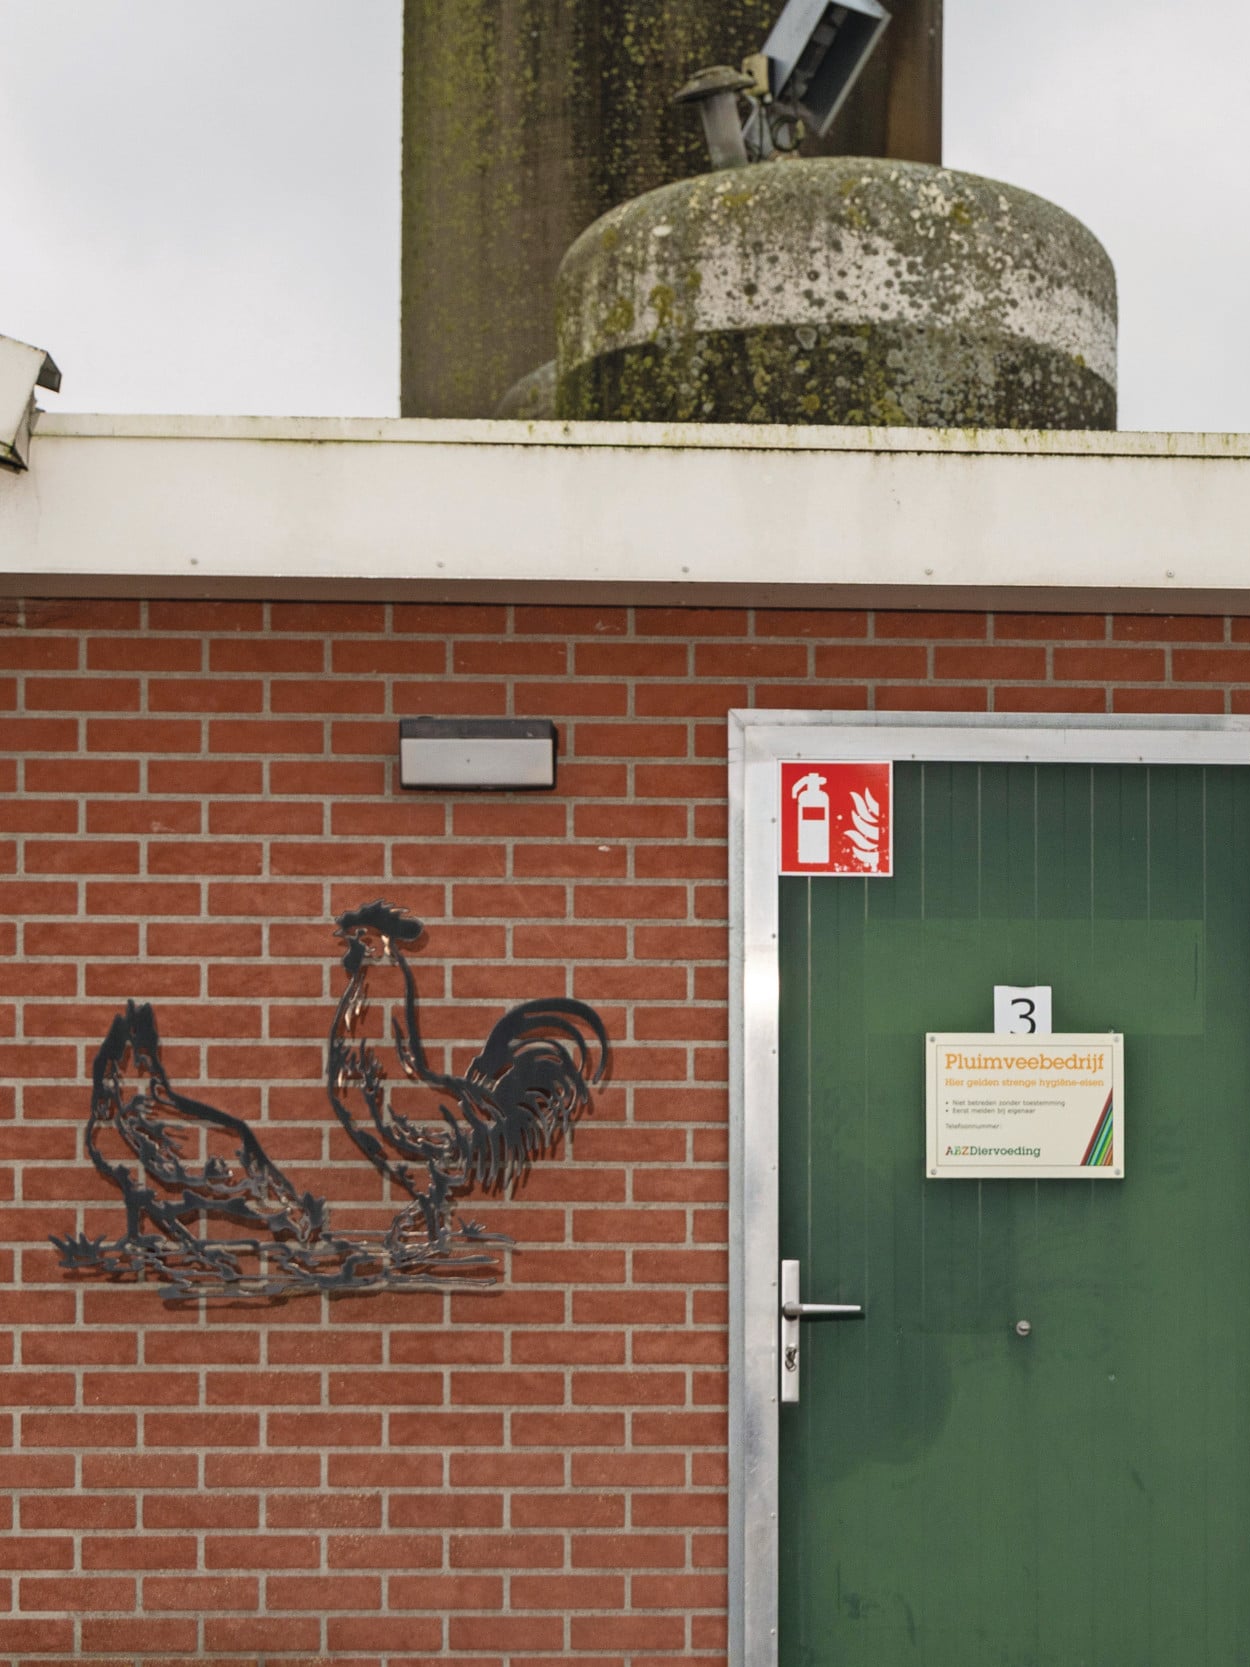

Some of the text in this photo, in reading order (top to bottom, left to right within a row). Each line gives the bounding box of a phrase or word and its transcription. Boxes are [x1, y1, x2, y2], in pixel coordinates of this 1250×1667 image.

[1010, 998, 1037, 1034] 3
[945, 1053, 1104, 1073] Pluimveebedrijf
[945, 1078, 964, 1087] Hier
[967, 1078, 1000, 1088] gelden
[1001, 1079, 1036, 1089] strenge
[952, 1099, 1065, 1108] Niet betreden zonder toestemming
[997, 1107, 1006, 1115] bij
[1007, 1107, 1036, 1115] eigenaar
